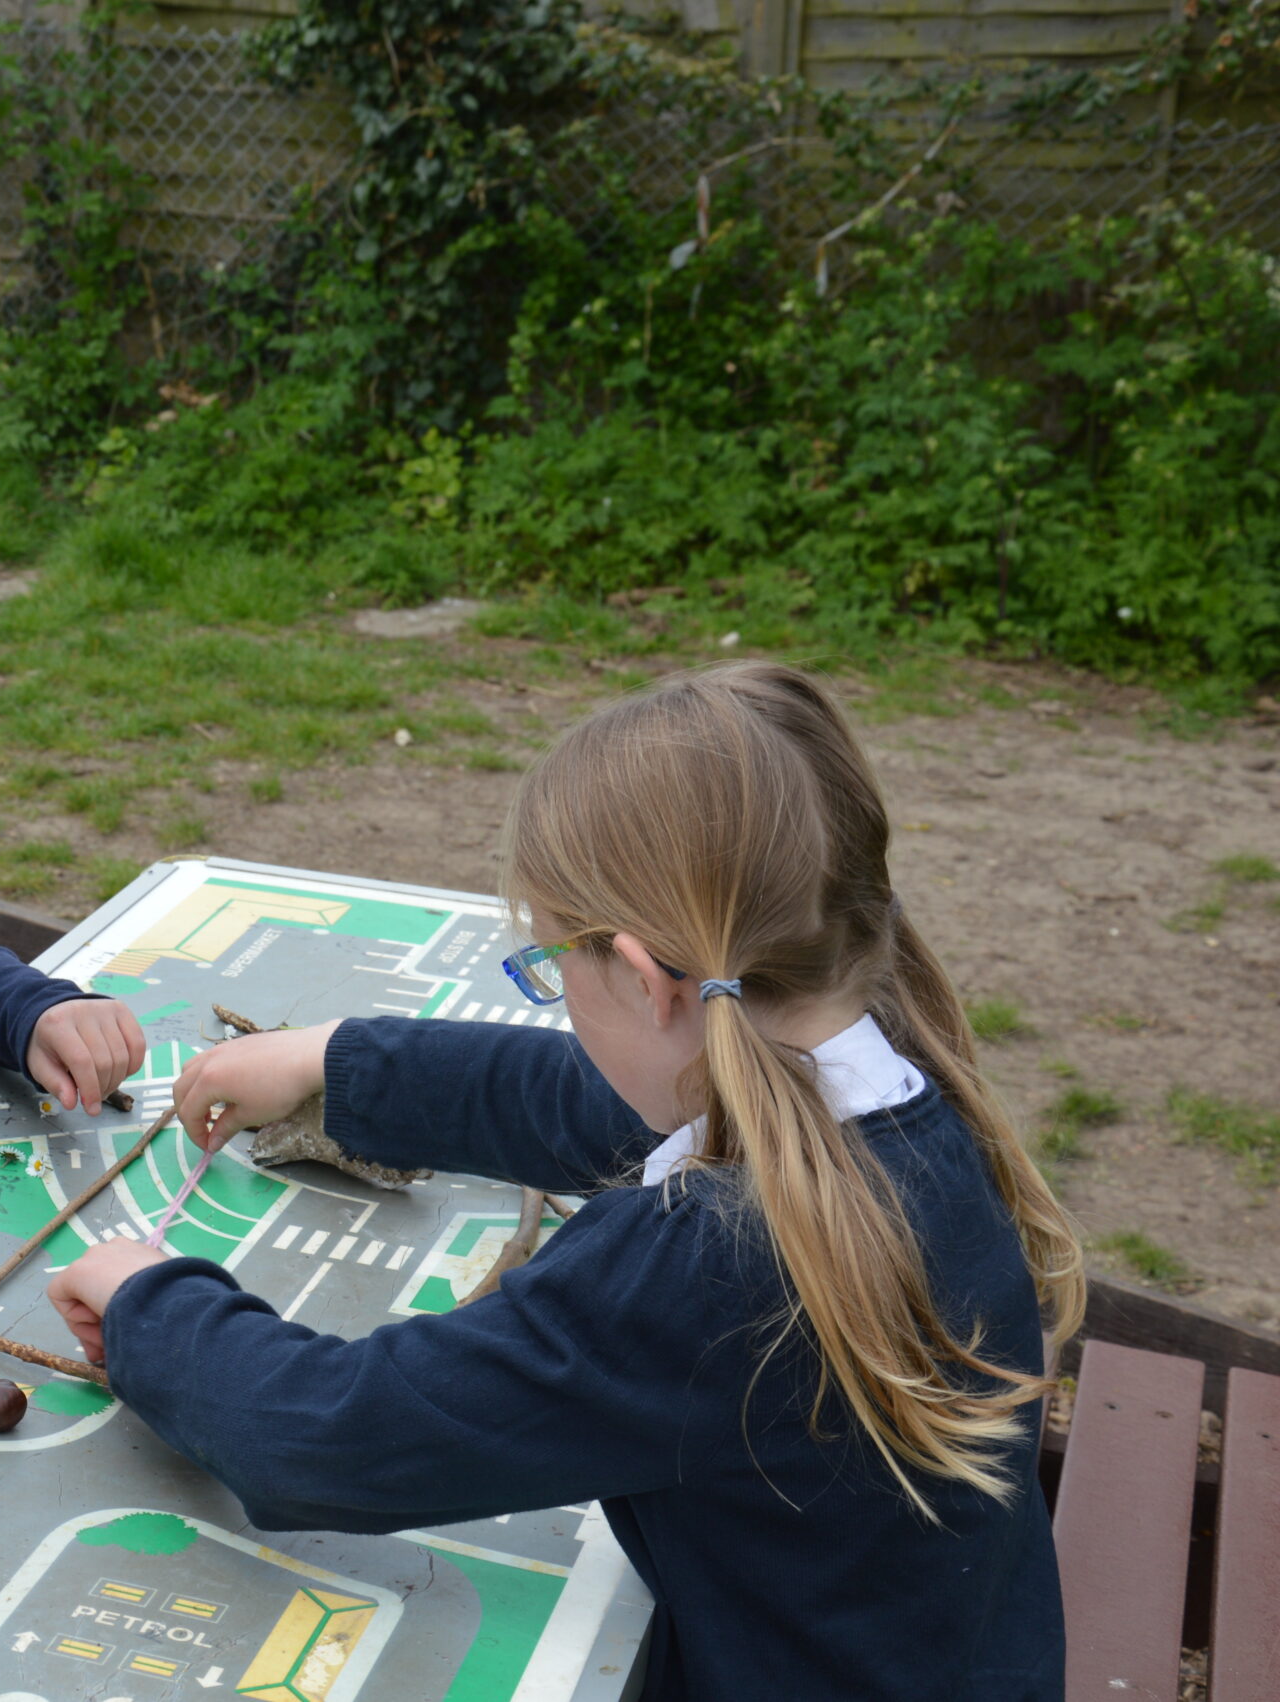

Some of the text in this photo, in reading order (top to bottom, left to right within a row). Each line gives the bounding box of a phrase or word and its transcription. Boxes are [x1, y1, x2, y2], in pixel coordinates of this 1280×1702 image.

[221, 927, 282, 978] SUPERMARKET
[438, 930, 477, 964] BUS STOP
[71, 1604, 214, 1649] PETROL
